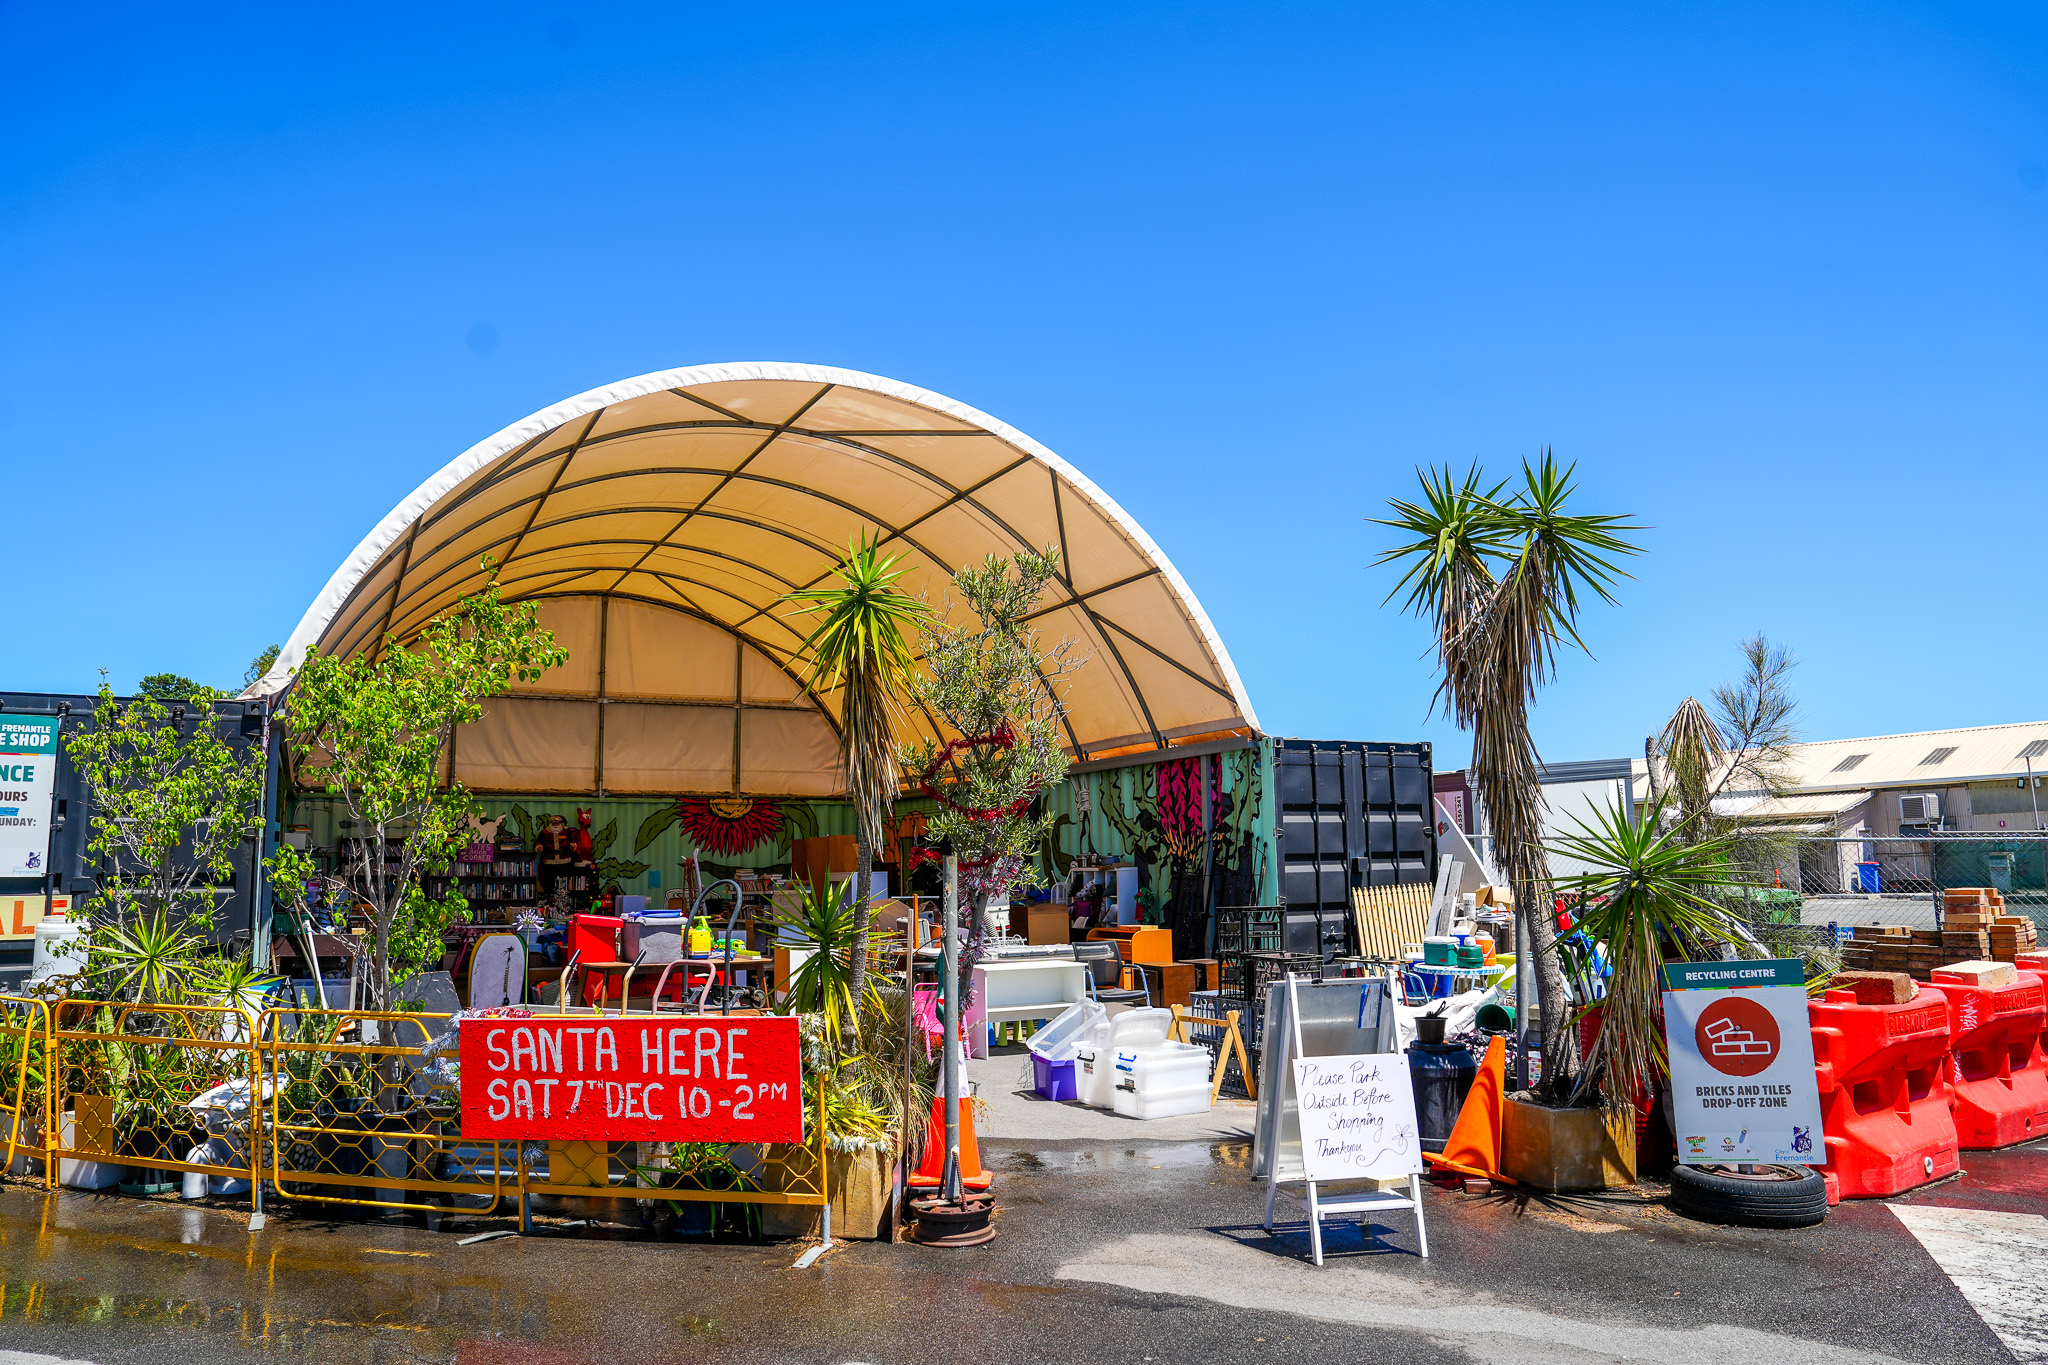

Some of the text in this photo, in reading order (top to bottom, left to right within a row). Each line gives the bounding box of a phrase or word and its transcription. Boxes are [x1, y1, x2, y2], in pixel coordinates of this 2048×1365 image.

[2, 724, 51, 733] FREMANTLE
[9, 733, 50, 746] SHOP
[1685, 968, 1776, 980] RECYCLING CENTRE
[486, 1027, 748, 1080] SANTA HERE
[1301, 1060, 1384, 1086] Please Park
[1304, 1087, 1395, 1111] Outside Before
[1696, 1084, 1792, 1096] BRICKS AND TILES
[487, 1078, 560, 1121] SAT
[605, 1081, 665, 1121] DEC
[1702, 1097, 1788, 1108] DROP-OFF ZONE
[1328, 1111, 1384, 1143] Shopping
